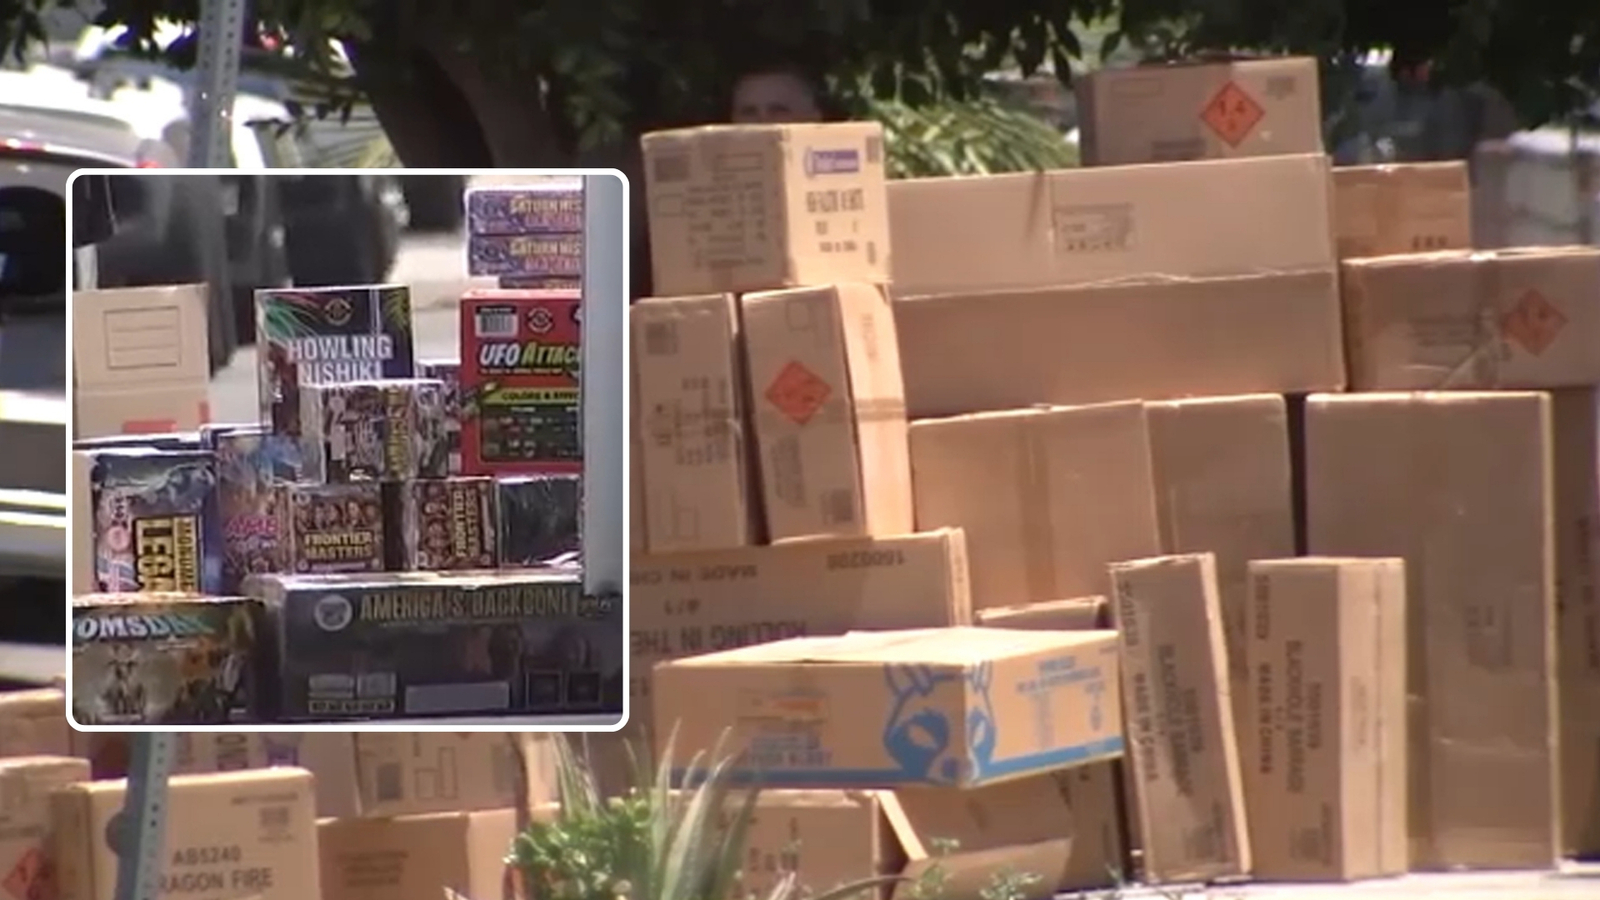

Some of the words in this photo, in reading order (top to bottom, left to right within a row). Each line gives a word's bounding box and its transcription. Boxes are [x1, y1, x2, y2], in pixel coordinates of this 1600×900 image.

[287, 334, 394, 360] HOWLING
[480, 343, 520, 366] UFO
[521, 342, 581, 365] ATTAC
[301, 360, 384, 384] NISHIKI
[303, 530, 373, 547] FRONTIER
[669, 567, 692, 584] IN
[701, 563, 758, 582] MADE
[360, 588, 466, 620] AMERICA'S
[73, 613, 216, 639] OMSDAY
[680, 626, 702, 652] IN
[1132, 672, 1150, 713] MADE
[1258, 663, 1271, 702] MADE
[1259, 708, 1271, 723] IN
[1139, 735, 1160, 781] CHINA
[1258, 727, 1273, 773] CHINA
[158, 872, 224, 893] RAGON
[232, 867, 273, 890] FIRE
